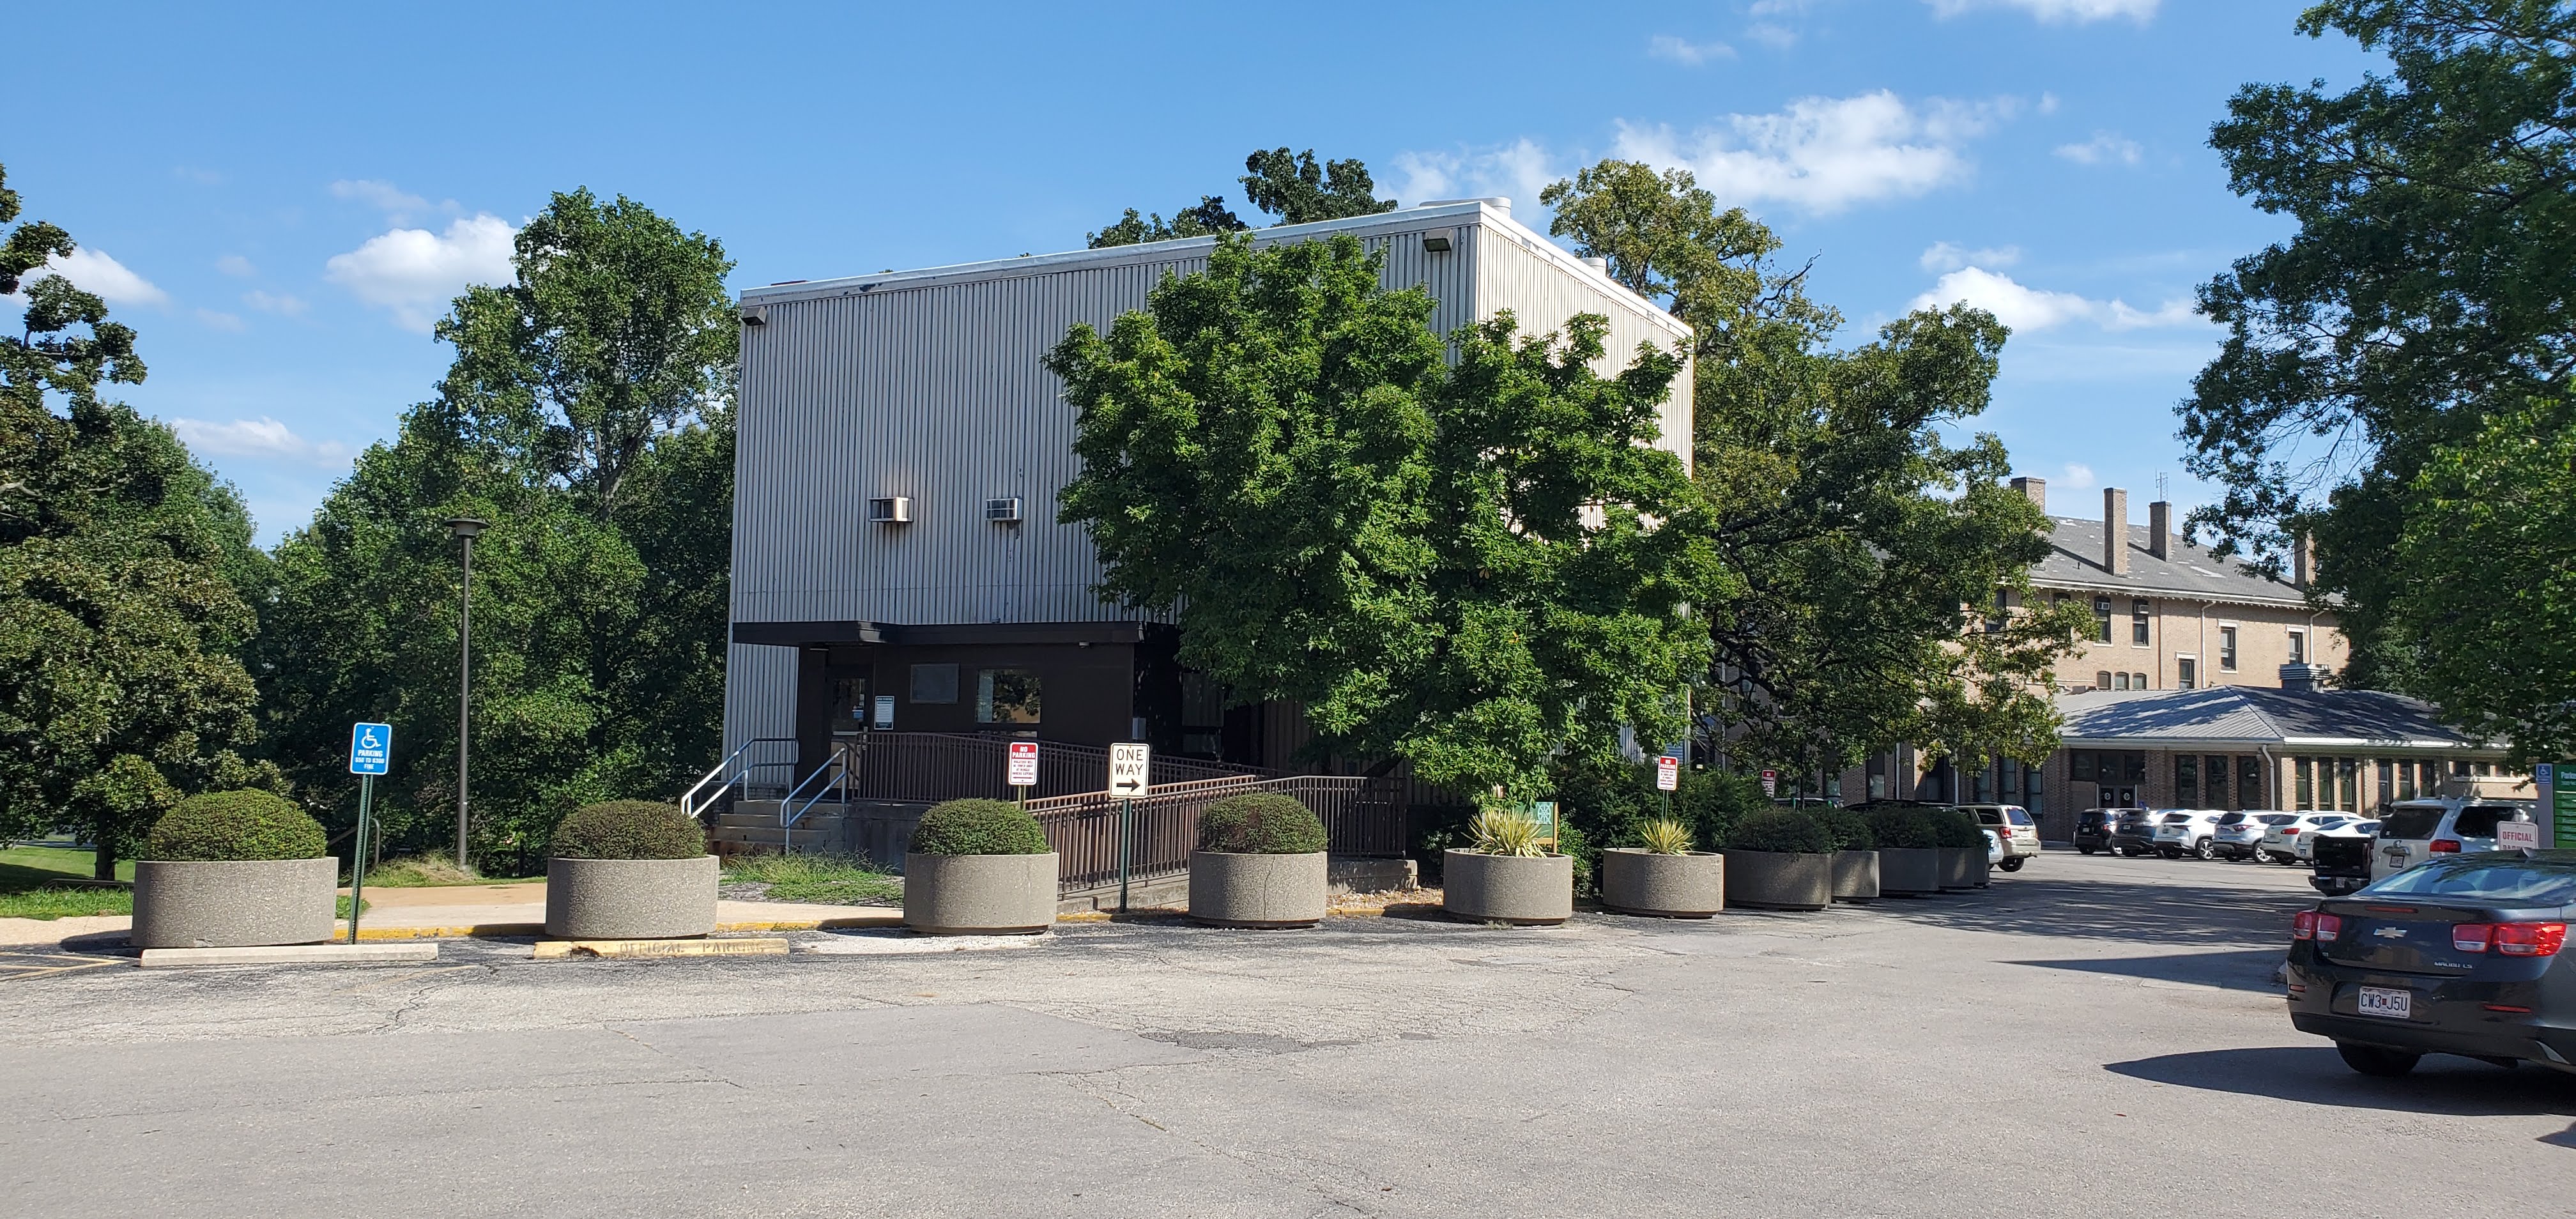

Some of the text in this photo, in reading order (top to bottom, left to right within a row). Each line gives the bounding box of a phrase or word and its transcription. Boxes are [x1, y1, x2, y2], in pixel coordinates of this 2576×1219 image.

[1117, 749, 1143, 761] ONE
[1116, 763, 1143, 776] WAY
[2503, 831, 2533, 842] OFFICIAL
[620, 942, 684, 954] OFFICIAL
[2361, 993, 2408, 1011] CW3 J5U
